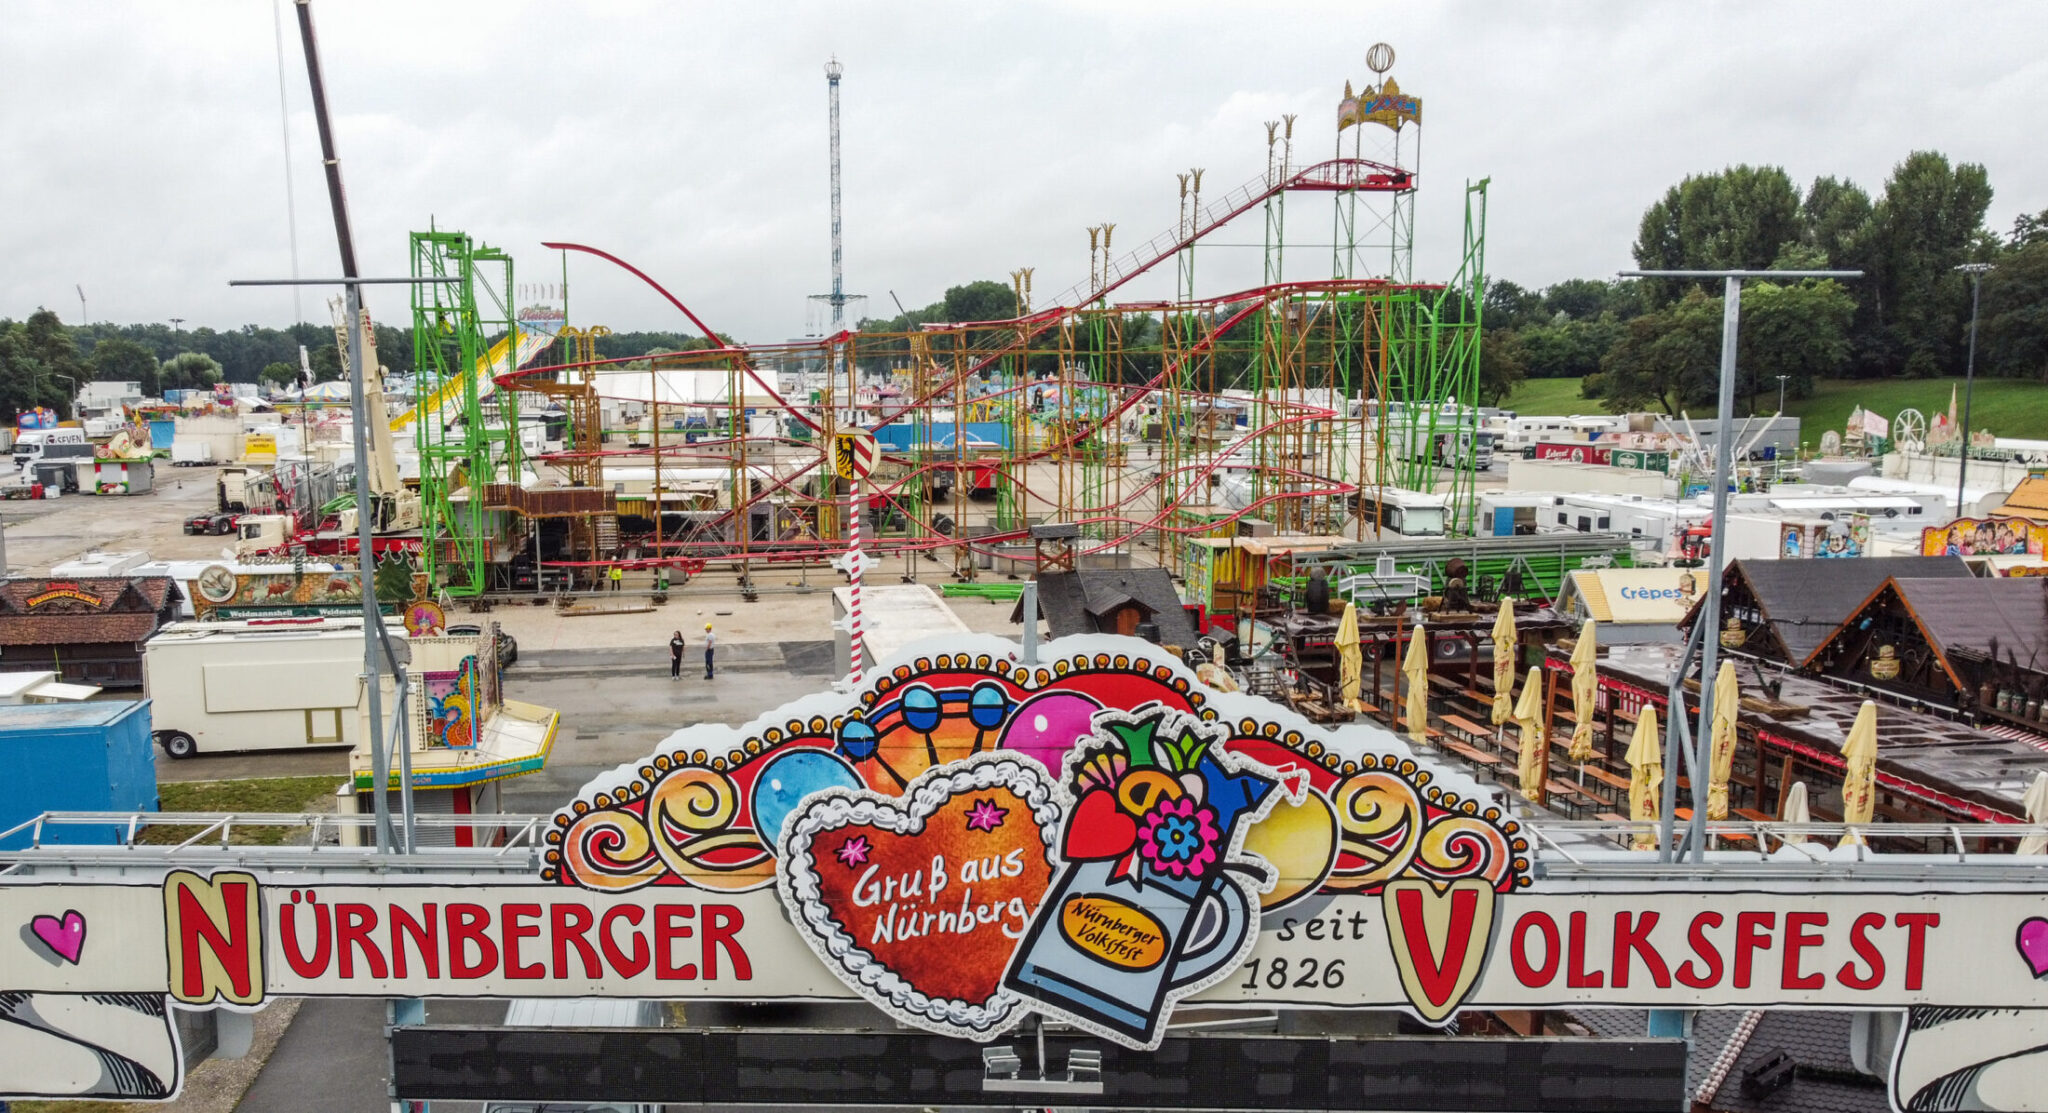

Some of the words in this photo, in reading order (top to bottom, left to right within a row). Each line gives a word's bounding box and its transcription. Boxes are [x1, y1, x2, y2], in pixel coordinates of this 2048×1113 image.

[1620, 586, 1683, 600] Crêpes
[851, 854, 948, 907] Gruß
[960, 848, 1024, 883] aus
[871, 888, 1030, 944] Nürnberg
[1071, 902, 1160, 945] Nürnberger
[1276, 908, 1368, 942] seit
[178, 882, 753, 998] NÜRNBERGER
[1396, 888, 1941, 1008] VOLKSFEST
[1077, 923, 1144, 960] Volksfest
[1241, 957, 1346, 990] 1826
